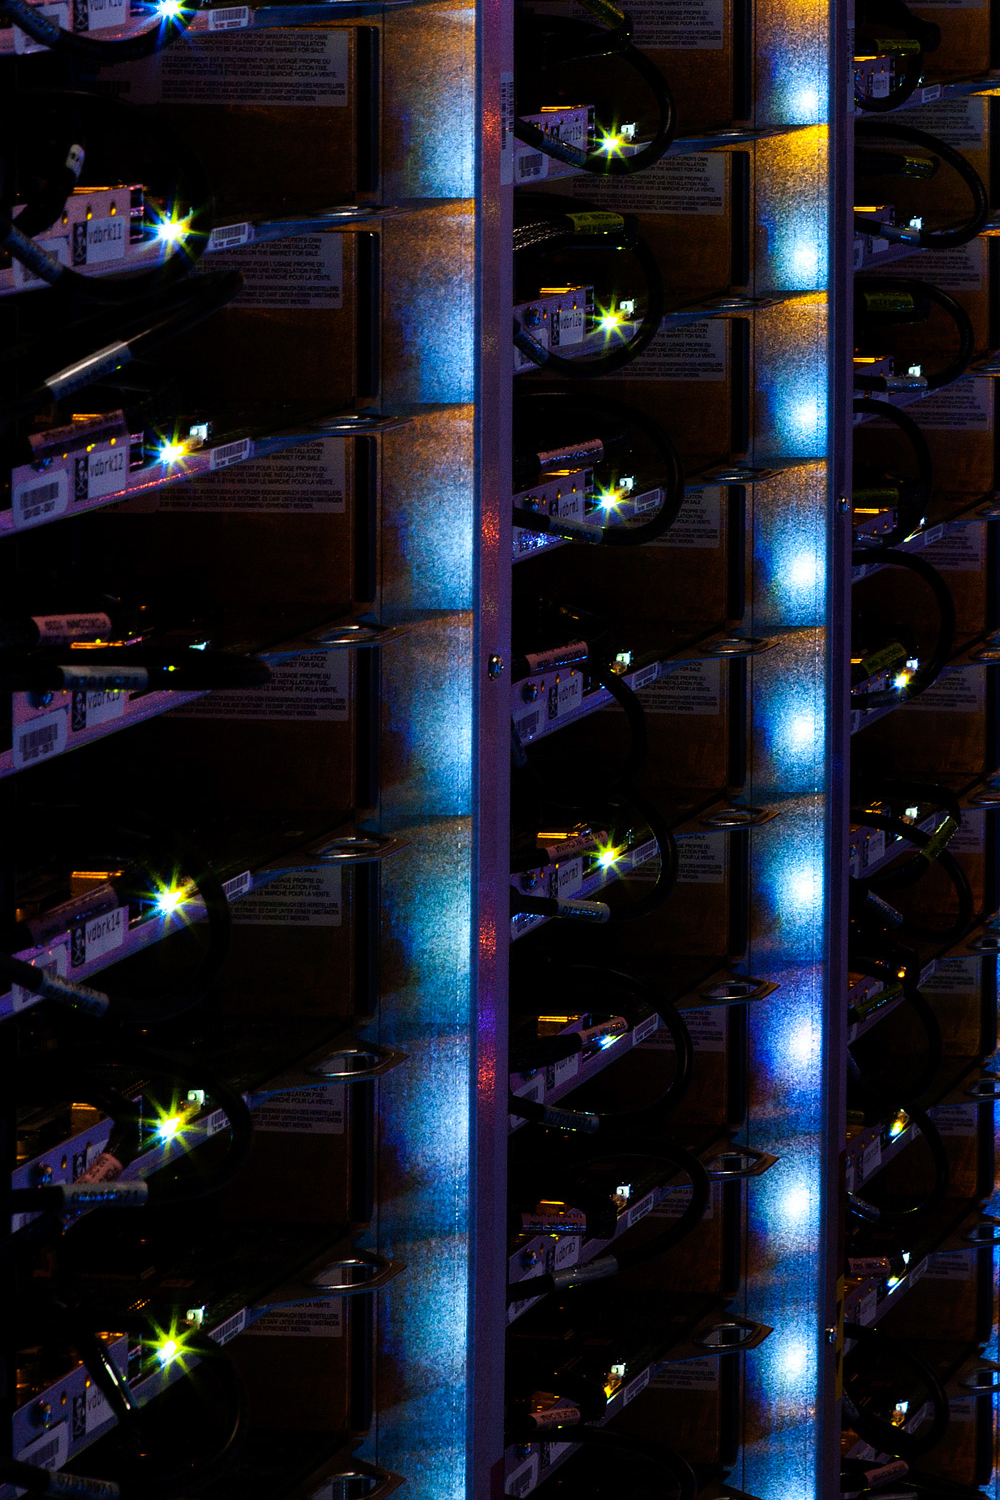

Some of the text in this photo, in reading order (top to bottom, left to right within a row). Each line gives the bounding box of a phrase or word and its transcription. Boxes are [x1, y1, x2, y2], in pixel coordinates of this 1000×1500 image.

[88, 222, 122, 246] vdbrk11
[89, 452, 124, 478] vdbrk12
[87, 918, 121, 944] vdbrk14
